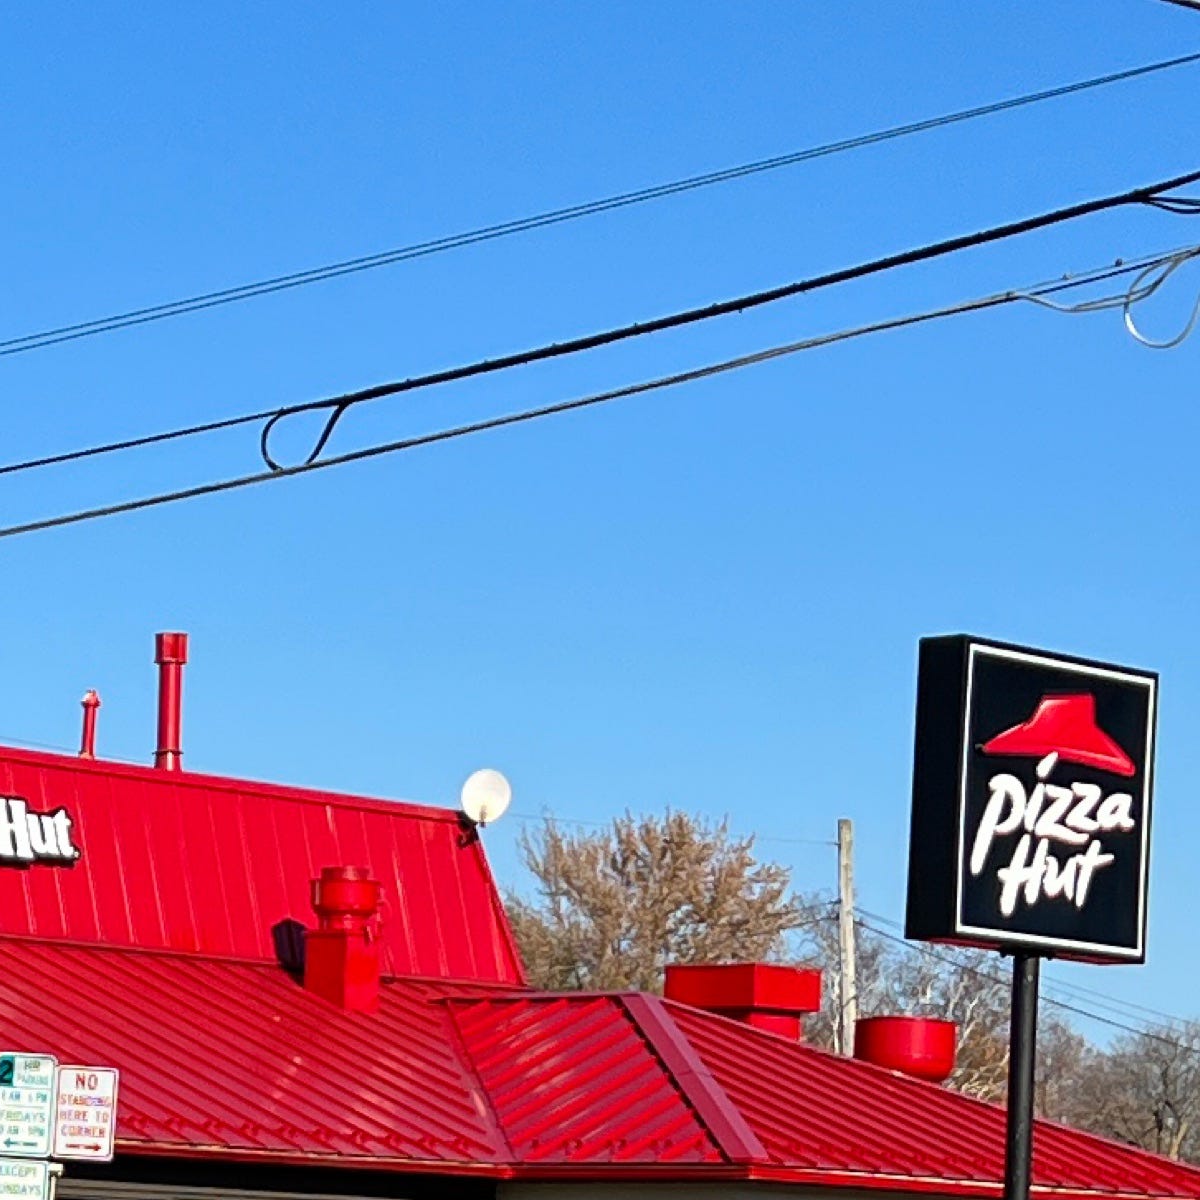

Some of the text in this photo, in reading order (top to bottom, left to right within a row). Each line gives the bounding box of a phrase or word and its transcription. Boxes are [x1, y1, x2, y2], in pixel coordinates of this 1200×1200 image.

[970, 751, 1134, 876] Pizza
[997, 834, 1115, 917] Hut
[0, 1060, 13, 1086] 2
[75, 1072, 99, 1091] NO
[59, 1094, 112, 1107] STANDING
[60, 1110, 110, 1123] HERE TO
[61, 1124, 106, 1138] CORNER
